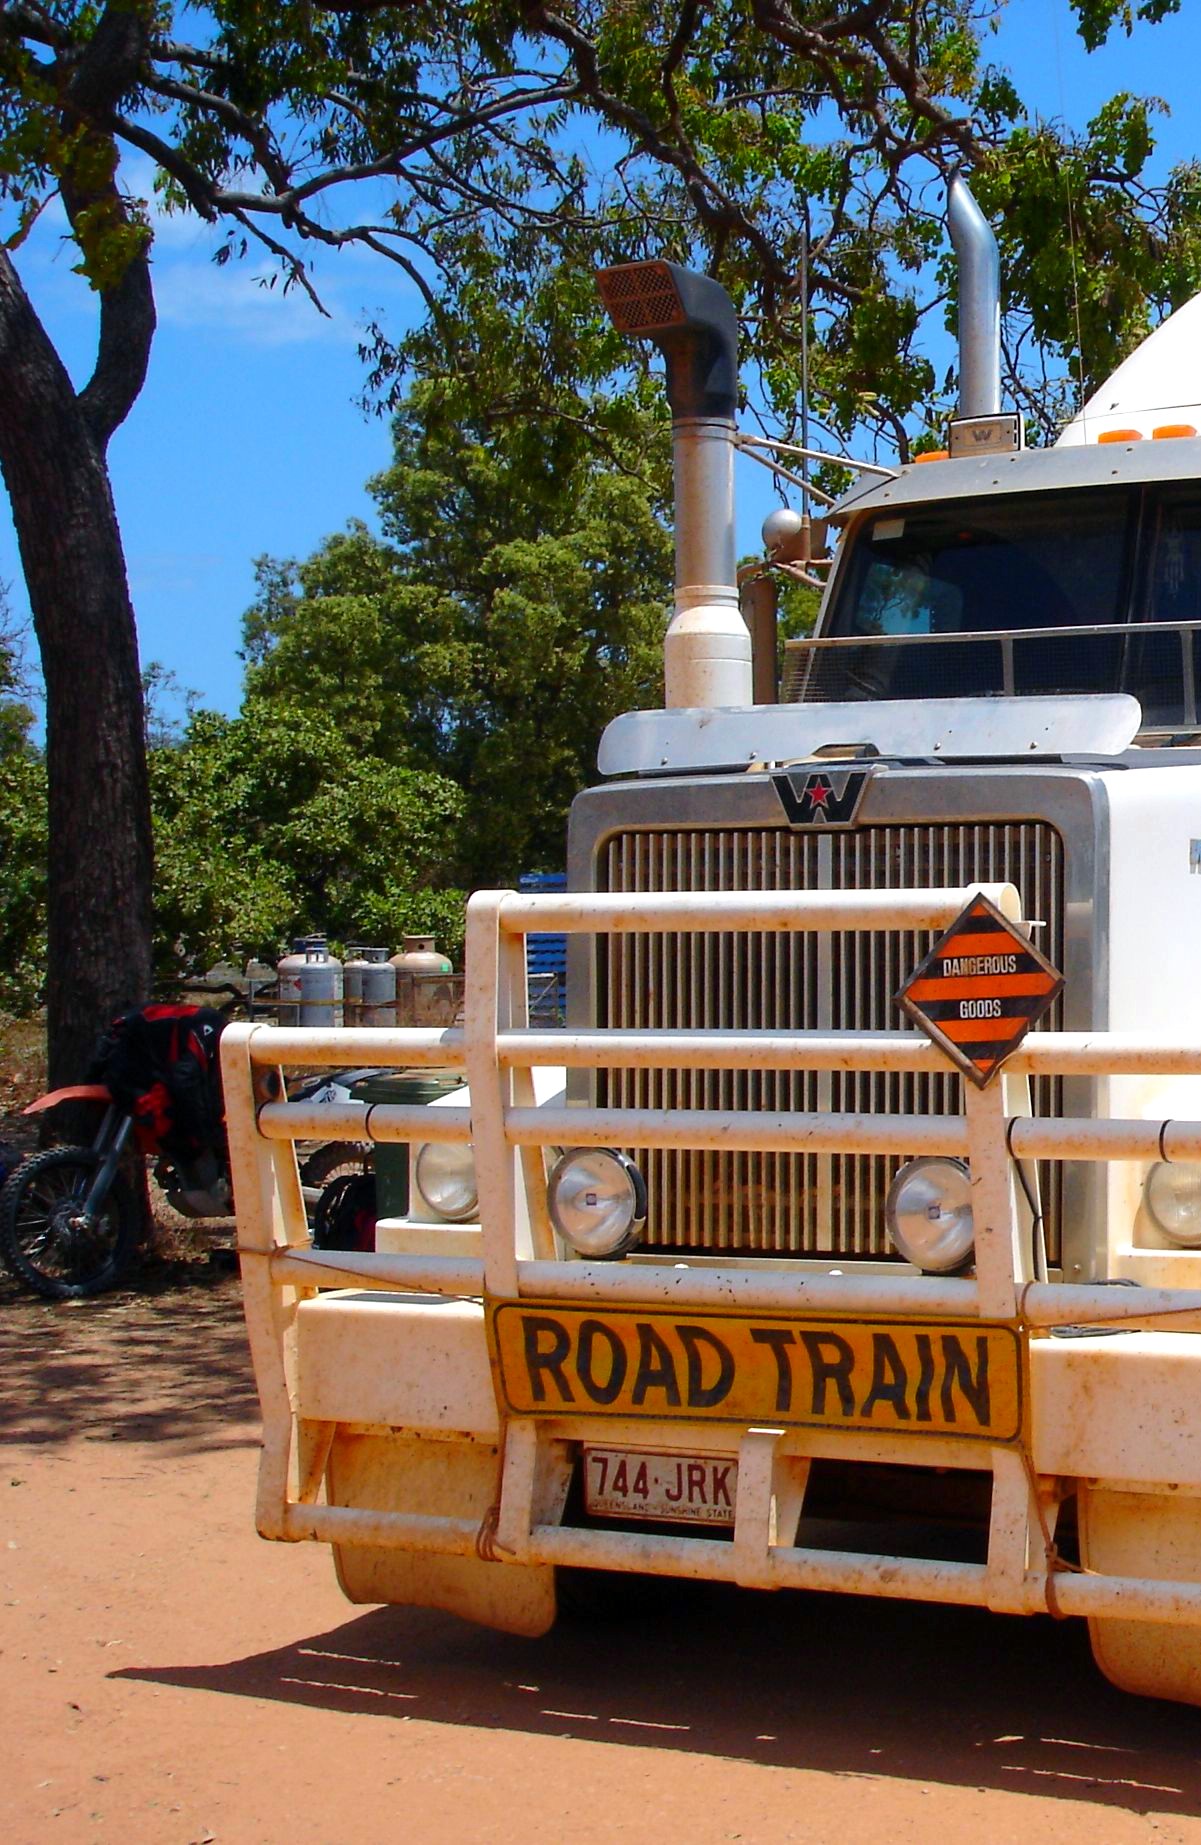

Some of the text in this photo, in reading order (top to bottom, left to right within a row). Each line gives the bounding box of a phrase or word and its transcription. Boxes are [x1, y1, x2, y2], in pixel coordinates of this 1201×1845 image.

[943, 955, 1017, 977] DANGEROUS
[959, 999, 1002, 1019] GOODS
[521, 1315, 992, 1427] ROAD TRAIN
